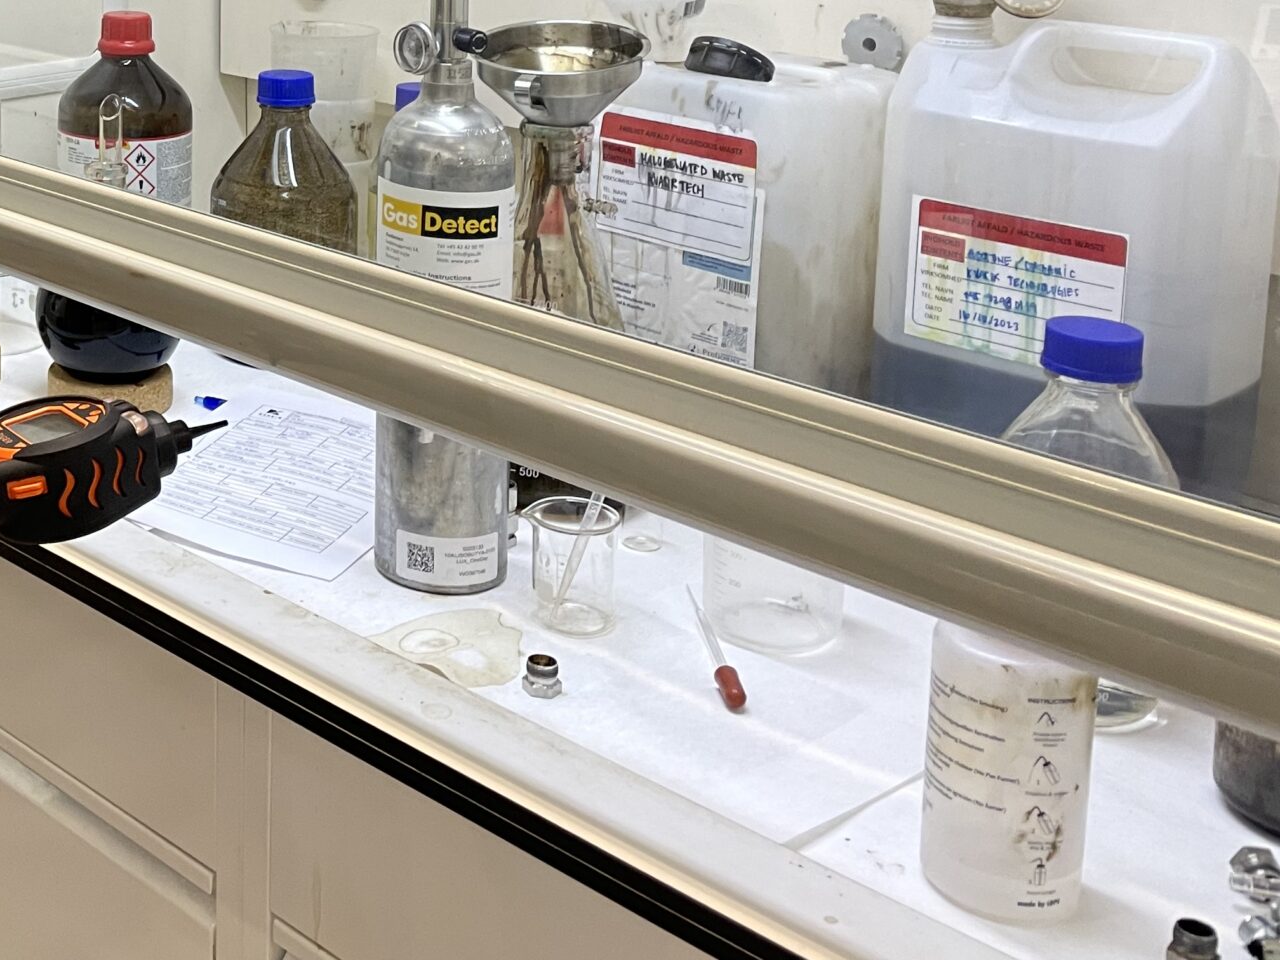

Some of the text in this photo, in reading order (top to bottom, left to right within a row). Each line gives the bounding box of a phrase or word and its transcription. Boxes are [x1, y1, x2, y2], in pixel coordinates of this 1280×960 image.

[712, 167, 744, 183] WASTE
[383, 202, 497, 234] Gas Detect
[519, 467, 540, 479] 500
